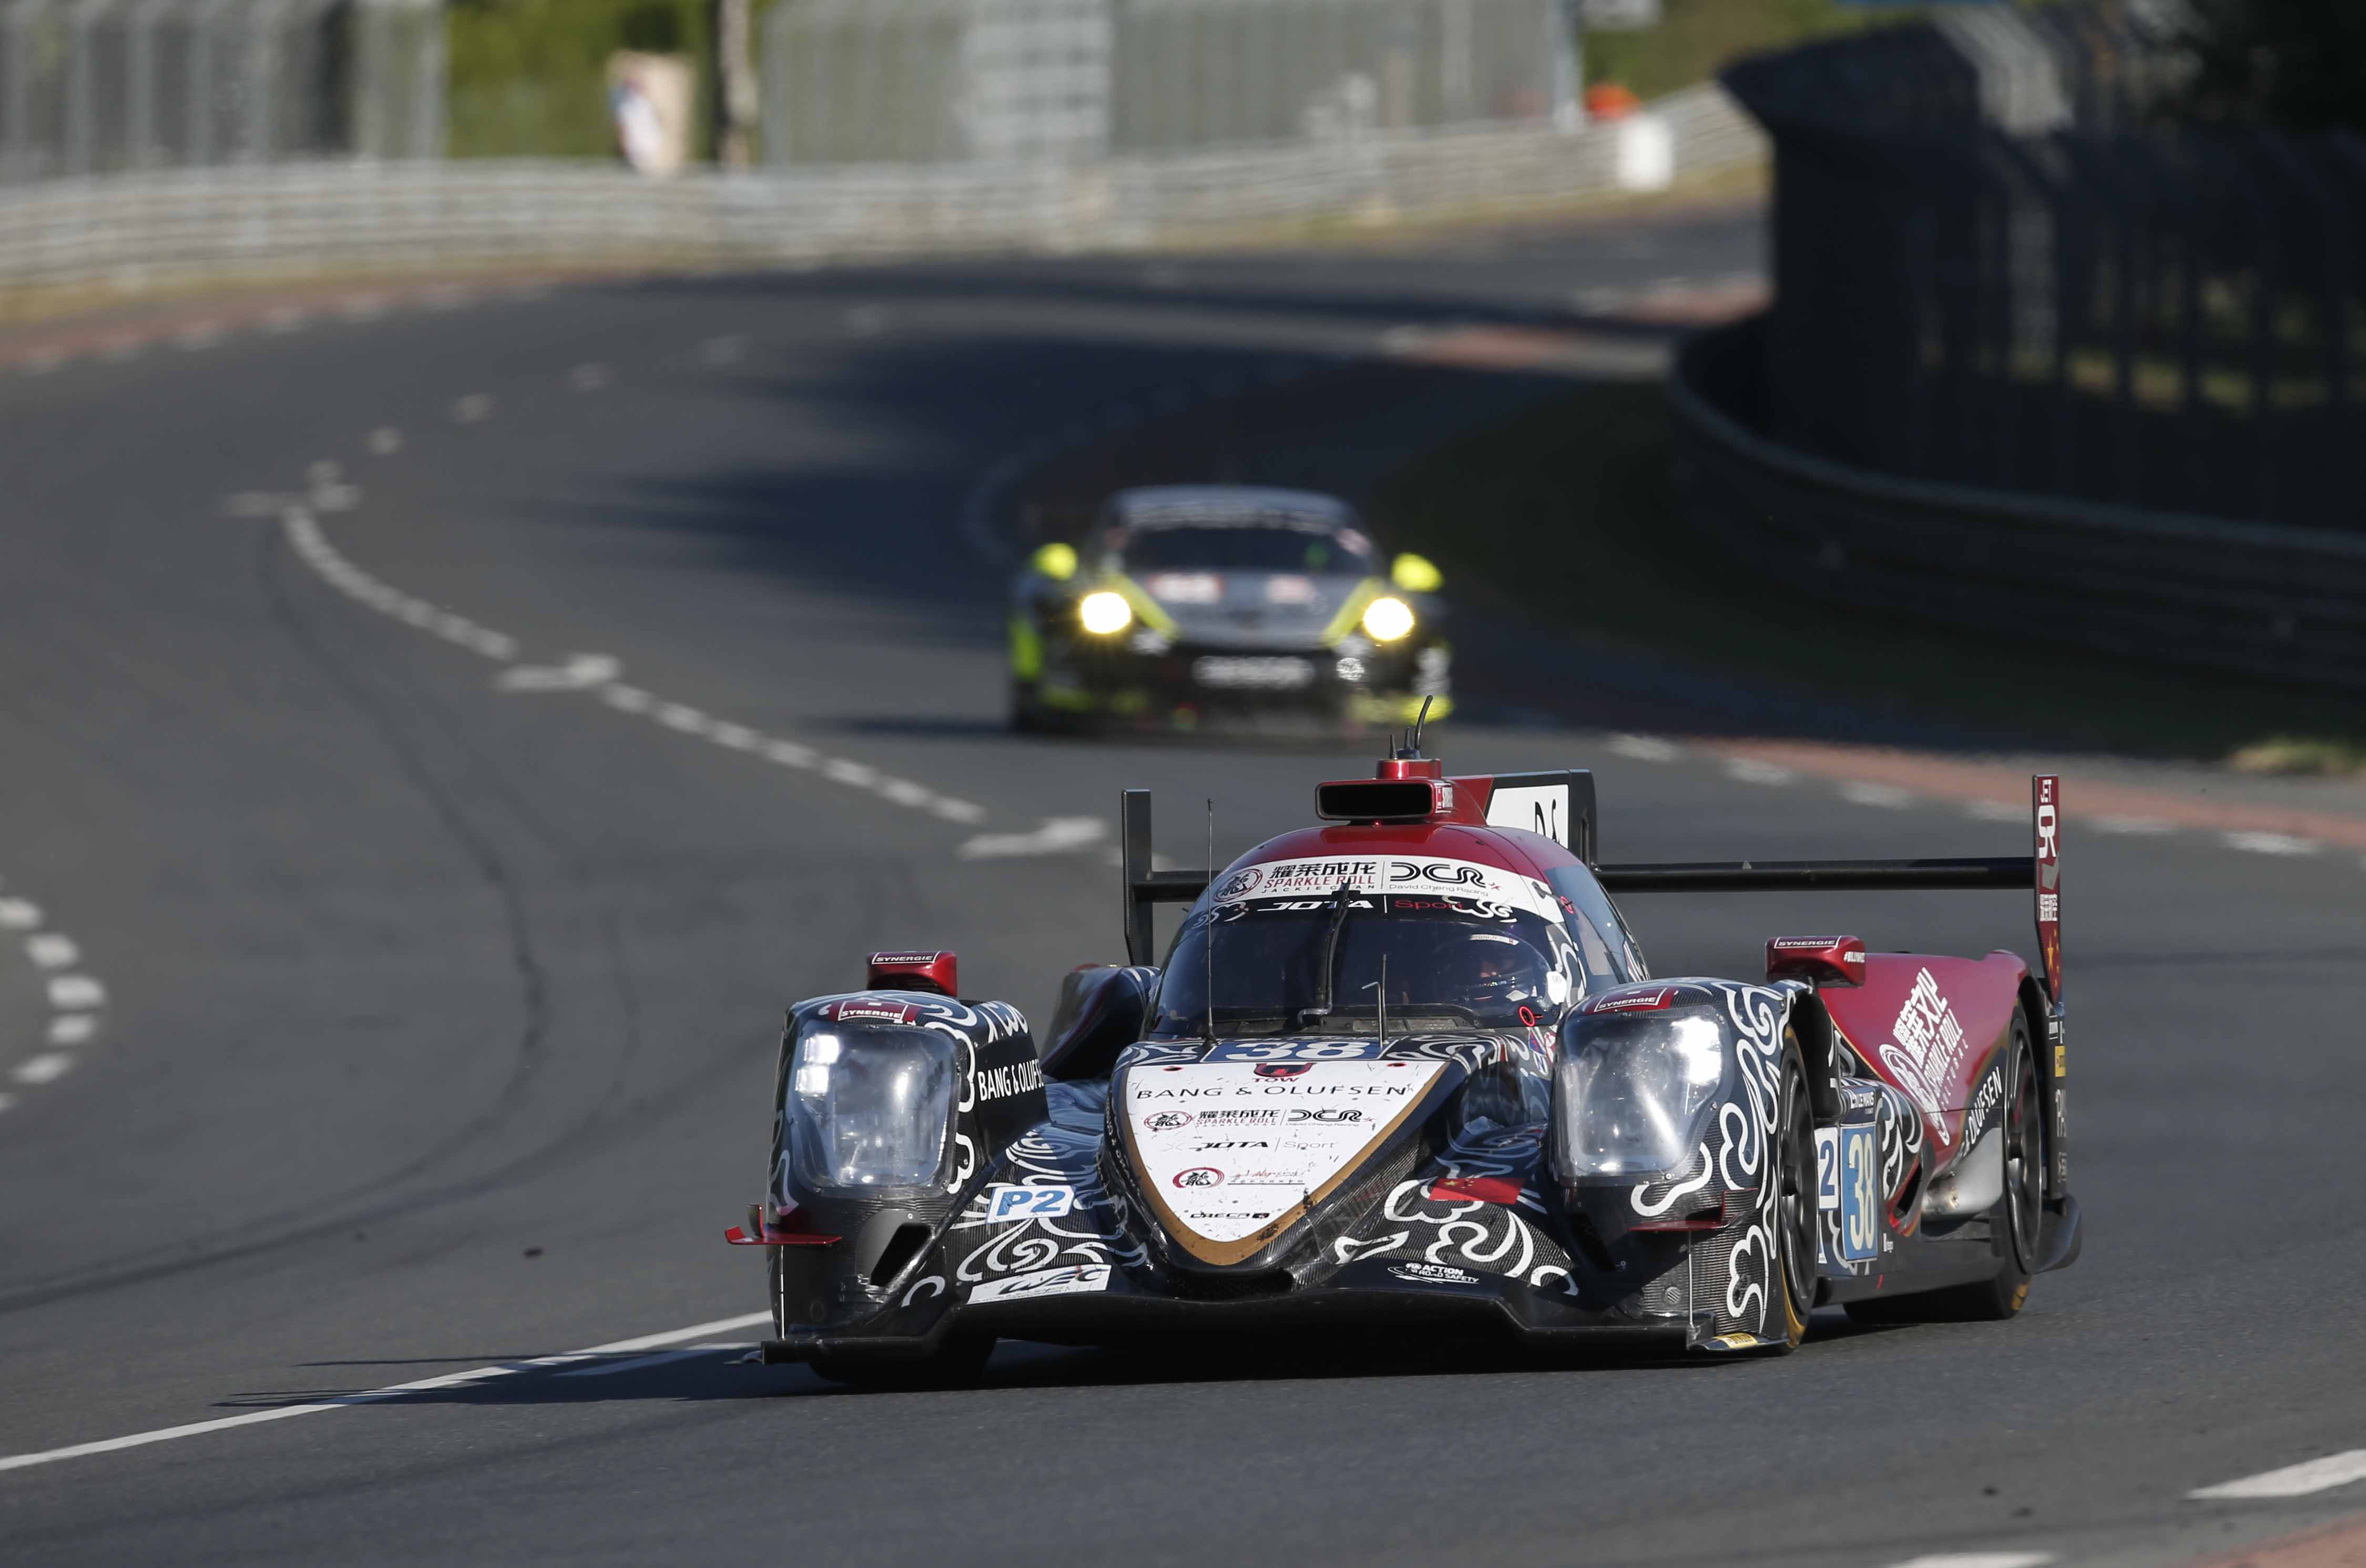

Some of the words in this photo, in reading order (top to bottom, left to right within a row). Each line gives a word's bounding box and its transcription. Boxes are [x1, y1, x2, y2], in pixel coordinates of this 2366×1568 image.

[1264, 876, 1333, 889] SPARKLE
[1336, 875, 1376, 885] ROLL
[1456, 887, 1488, 896] Racing
[1598, 996, 1657, 1009] SYNERGIE
[841, 1010, 902, 1018] SYNERGIE
[1226, 1041, 1371, 1060] 38
[978, 1066, 1012, 1102] BANG
[1012, 1065, 1020, 1094] &
[1137, 1087, 1224, 1099] BANG
[1235, 1085, 1252, 1096] &
[1264, 1085, 1406, 1096] OLUFSEN
[1969, 1066, 2003, 1145] OLUFSEN
[1189, 1141, 1269, 1149] JOTA
[1283, 1141, 1335, 1150] Sport
[1848, 1133, 1874, 1251] 38
[995, 1190, 1066, 1216] P2
[1422, 1265, 1464, 1276] ACTION
[1444, 1274, 1480, 1283] SAFETY
